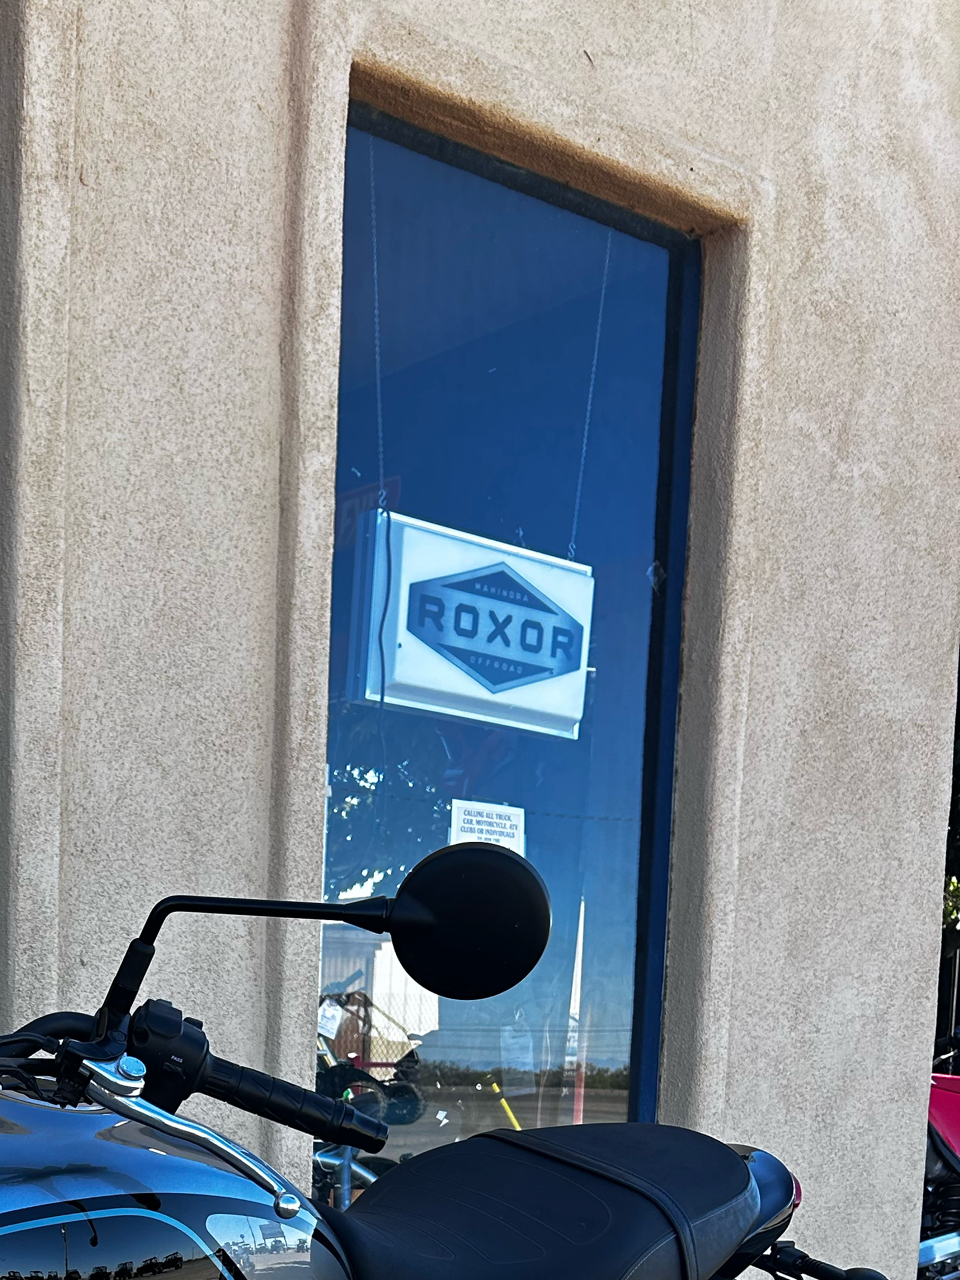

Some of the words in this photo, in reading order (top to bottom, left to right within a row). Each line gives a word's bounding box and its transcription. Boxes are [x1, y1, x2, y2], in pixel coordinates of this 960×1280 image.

[474, 581, 529, 602] MAHINDRA
[418, 593, 574, 662] ROXOR
[469, 655, 523, 675] OFFROAD
[463, 809, 484, 818] CALLING
